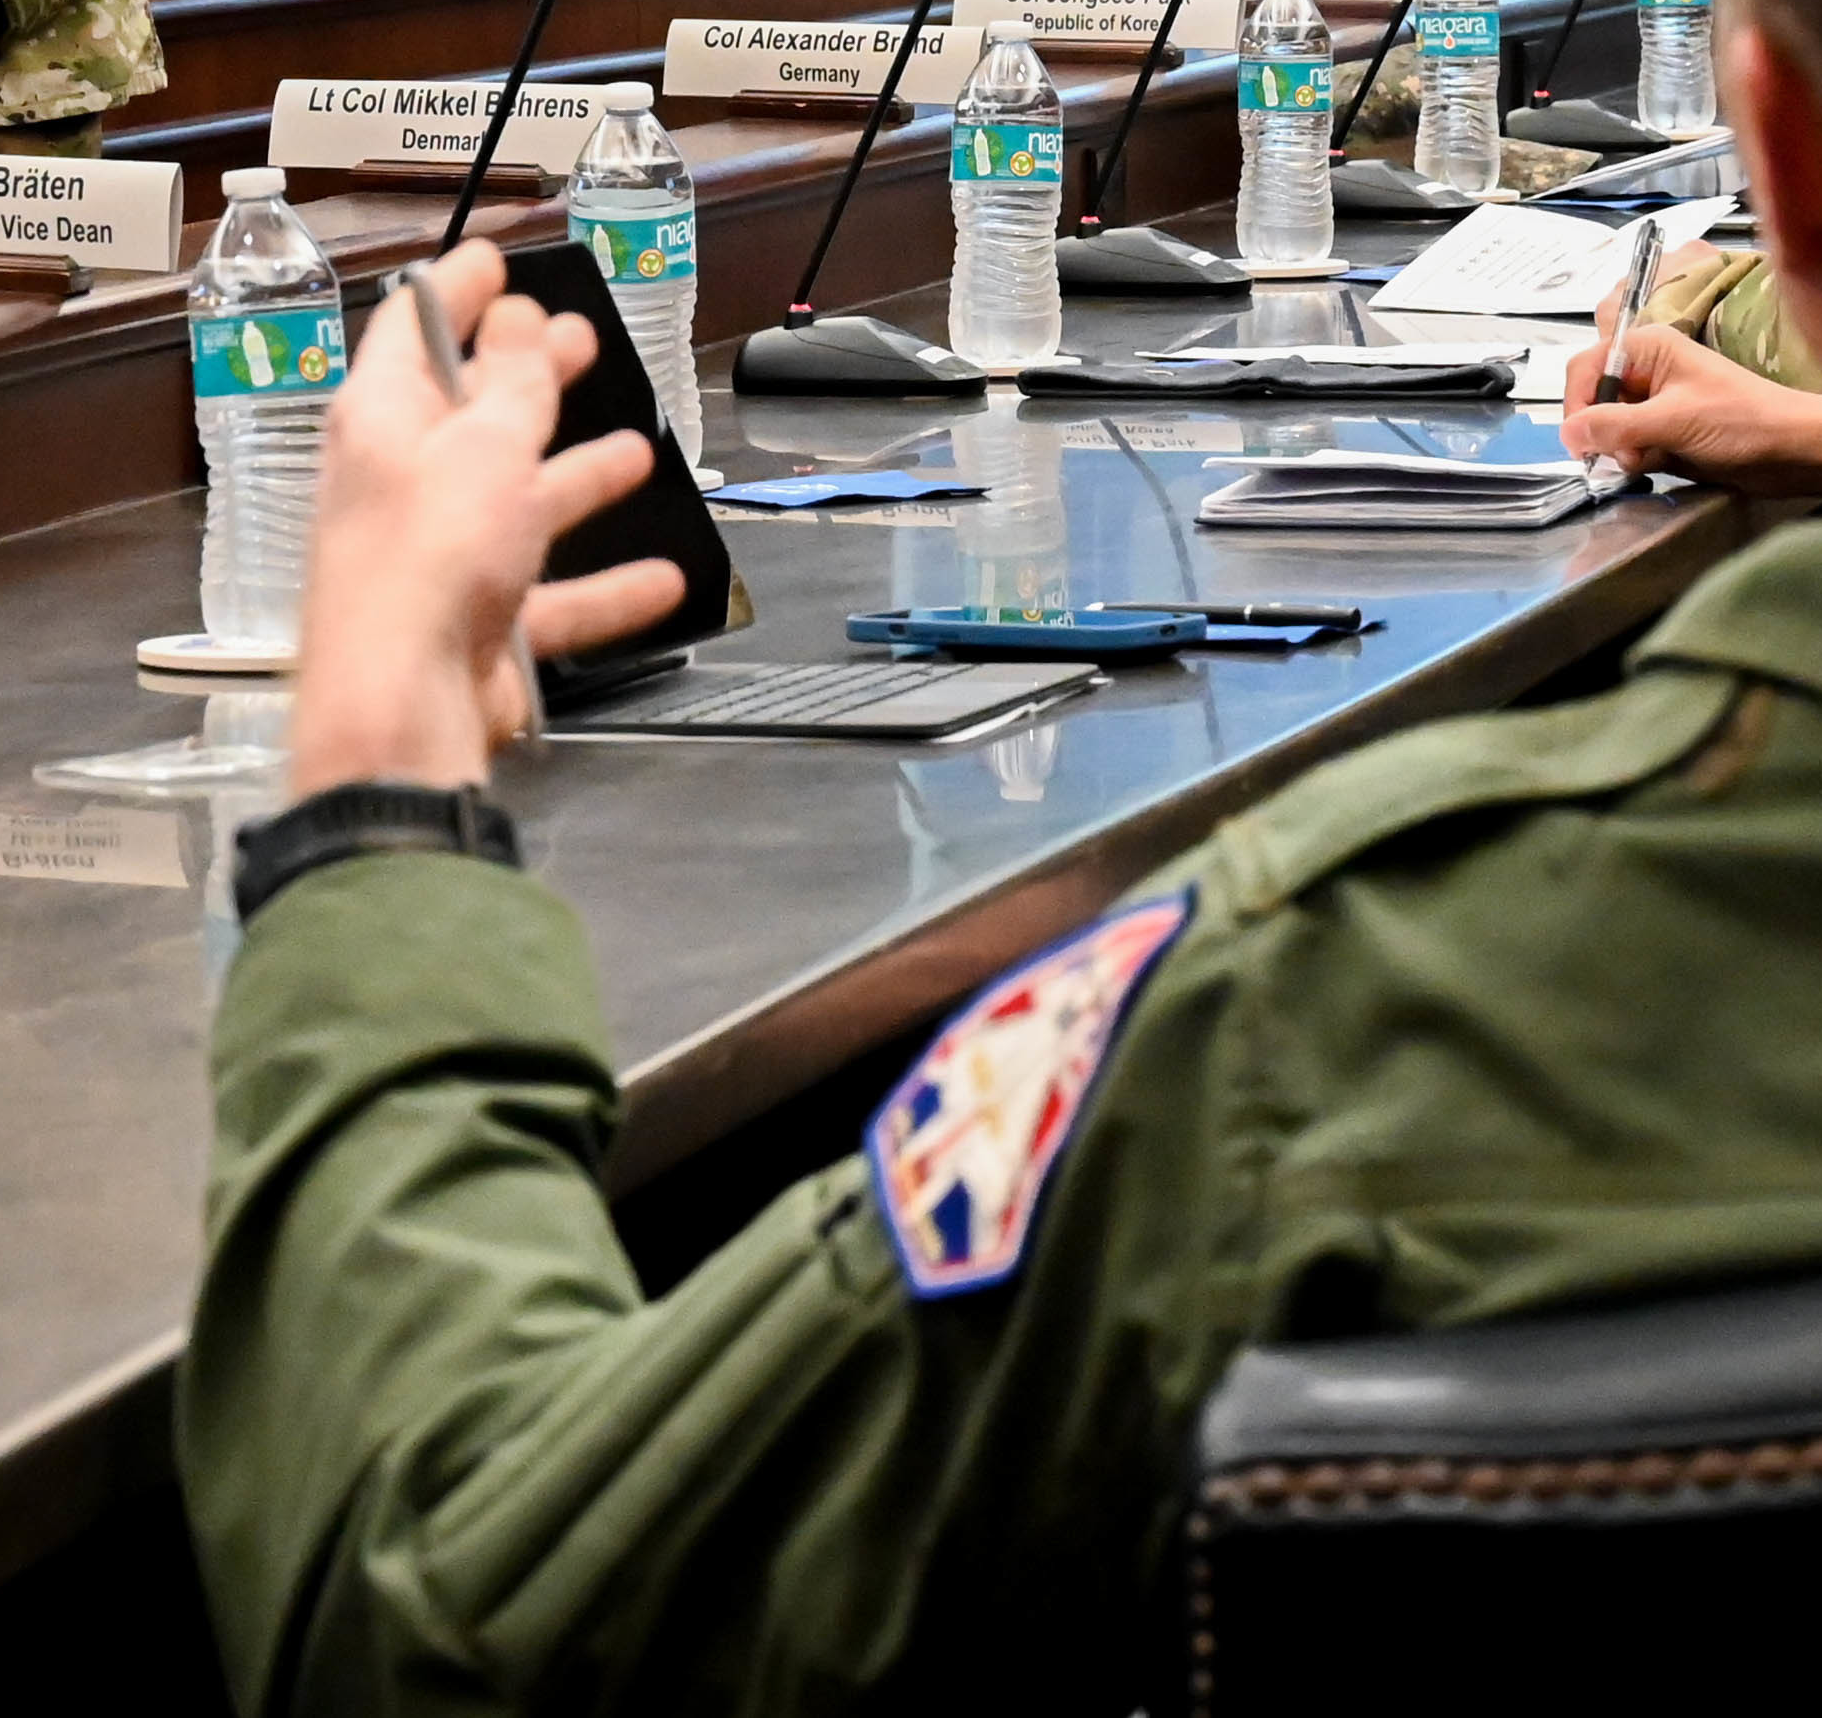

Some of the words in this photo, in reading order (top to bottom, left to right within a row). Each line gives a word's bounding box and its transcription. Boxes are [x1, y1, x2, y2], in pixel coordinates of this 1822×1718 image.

[1023, 12, 1094, 33] Republic
[1099, 14, 1116, 31] of
[1120, 14, 1160, 32] Kore
[1419, 16, 1487, 38] niagara
[703, 26, 744, 50] Col
[747, 27, 867, 54] Alexander
[873, 29, 945, 54] Brnd
[779, 62, 861, 88] Germany
[307, 87, 336, 113] Lt
[341, 88, 387, 114] Col
[393, 88, 478, 116] Mikkel
[484, 91, 590, 119] Bhrens
[402, 128, 487, 151] Denmar
[1, 214, 49, 241] Vice
[56, 216, 113, 244] Dean
